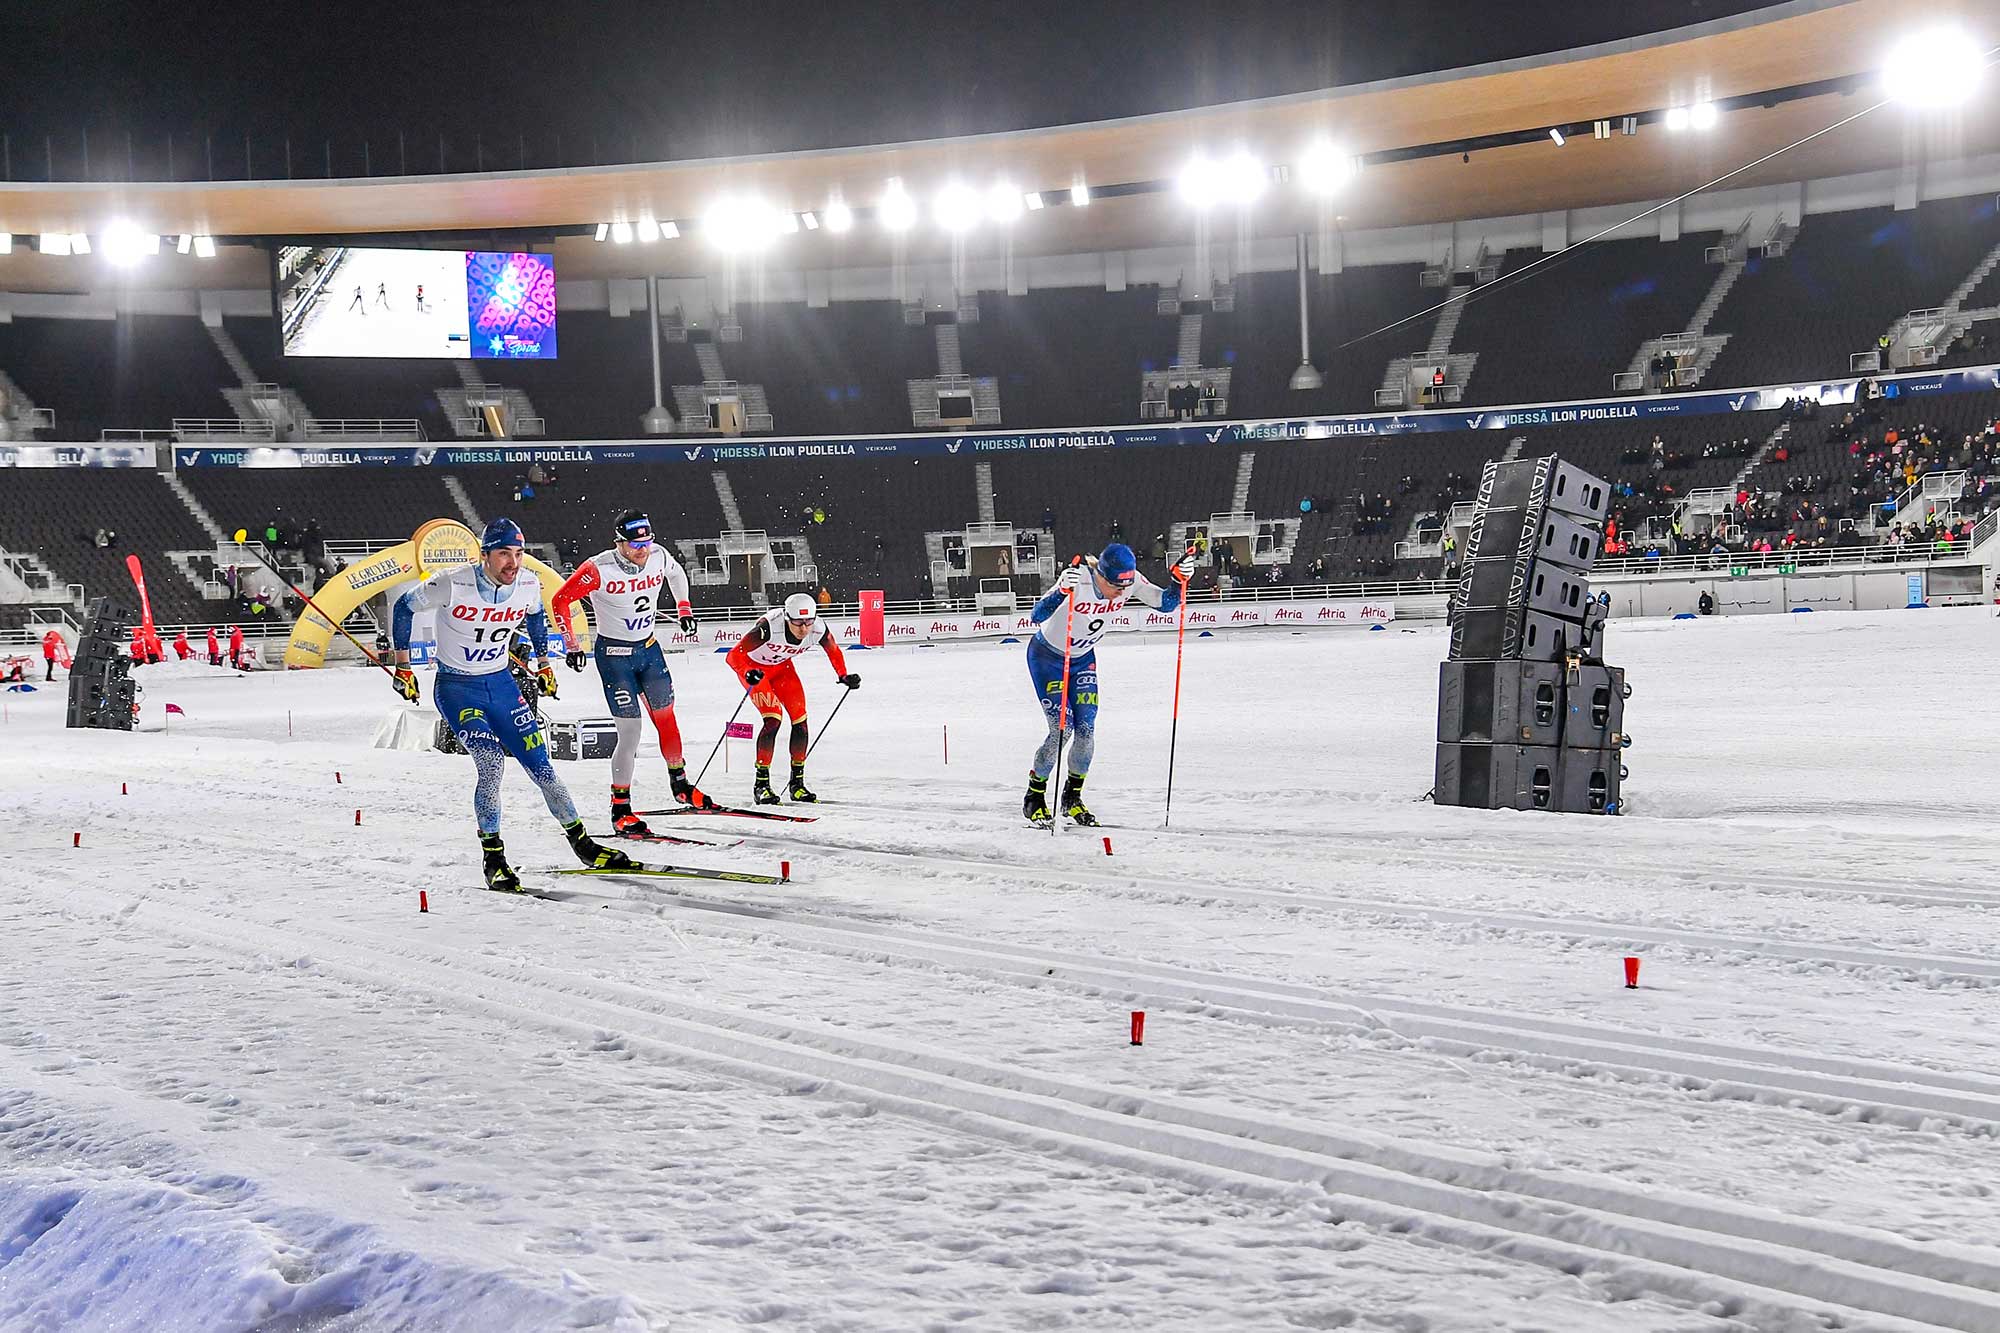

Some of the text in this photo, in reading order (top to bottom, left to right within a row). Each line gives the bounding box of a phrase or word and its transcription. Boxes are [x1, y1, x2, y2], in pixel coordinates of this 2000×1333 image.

[1910, 383, 1943, 391] VEIKKAUS
[1551, 410, 1576, 422] ILON
[1580, 406, 1638, 420] PUOLELLA
[1648, 405, 1680, 413] VEIKKAUS
[1289, 425, 1308, 437] ILO
[1324, 422, 1376, 436] UOLELLA
[973, 436, 1026, 451] YHDESSÄ
[1029, 438, 1055, 449] ILON
[1058, 435, 1115, 448] PUOLELLA
[448, 449, 502, 463] YHDESSÄ
[505, 451, 531, 462] ILON
[535, 450, 593, 462] PUOLELLA
[712, 444, 766, 458] YHDESSÄ
[769, 446, 795, 457] ILON
[798, 444, 855, 456] PUOLELLA
[211, 452, 250, 465] YHDES
[302, 453, 361, 464] PUOLELLA
[628, 569, 663, 592] Taksi
[634, 595, 651, 613] 2
[482, 603, 529, 623] Taksi
[1189, 611, 1216, 623] Atria
[1231, 610, 1259, 621] Atria
[1274, 608, 1303, 619] Atria
[1317, 607, 1346, 619] Atria
[1360, 606, 1387, 618] Atria
[973, 620, 1001, 631] Atria
[1146, 613, 1174, 625] Atria
[844, 625, 860, 638] Atr
[888, 623, 916, 636] Atria
[930, 622, 959, 633] Atria
[1087, 618, 1105, 636] 9
[460, 644, 506, 662] VISA
